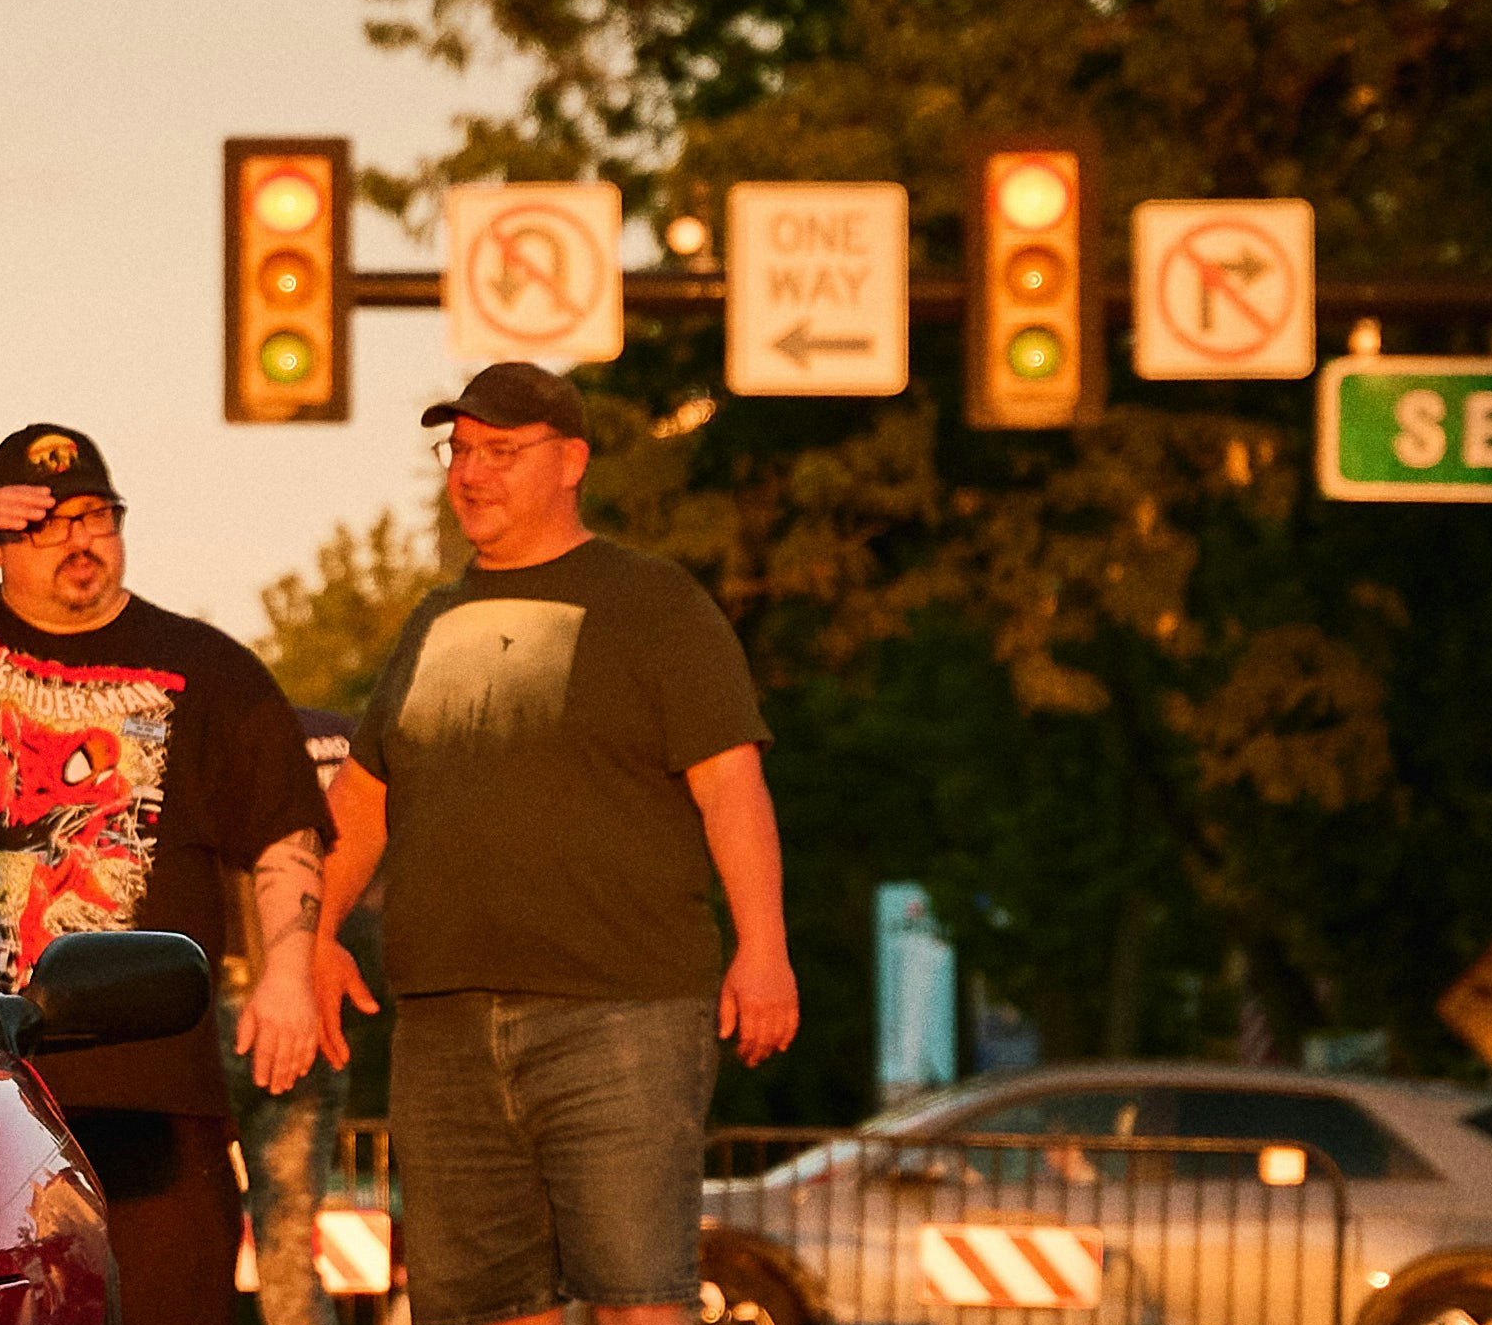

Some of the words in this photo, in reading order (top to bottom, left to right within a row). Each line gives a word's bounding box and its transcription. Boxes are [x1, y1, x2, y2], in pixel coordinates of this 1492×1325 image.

[770, 212, 868, 256] ONE
[768, 267, 871, 306] WAY
[1392, 389, 1447, 469] S
